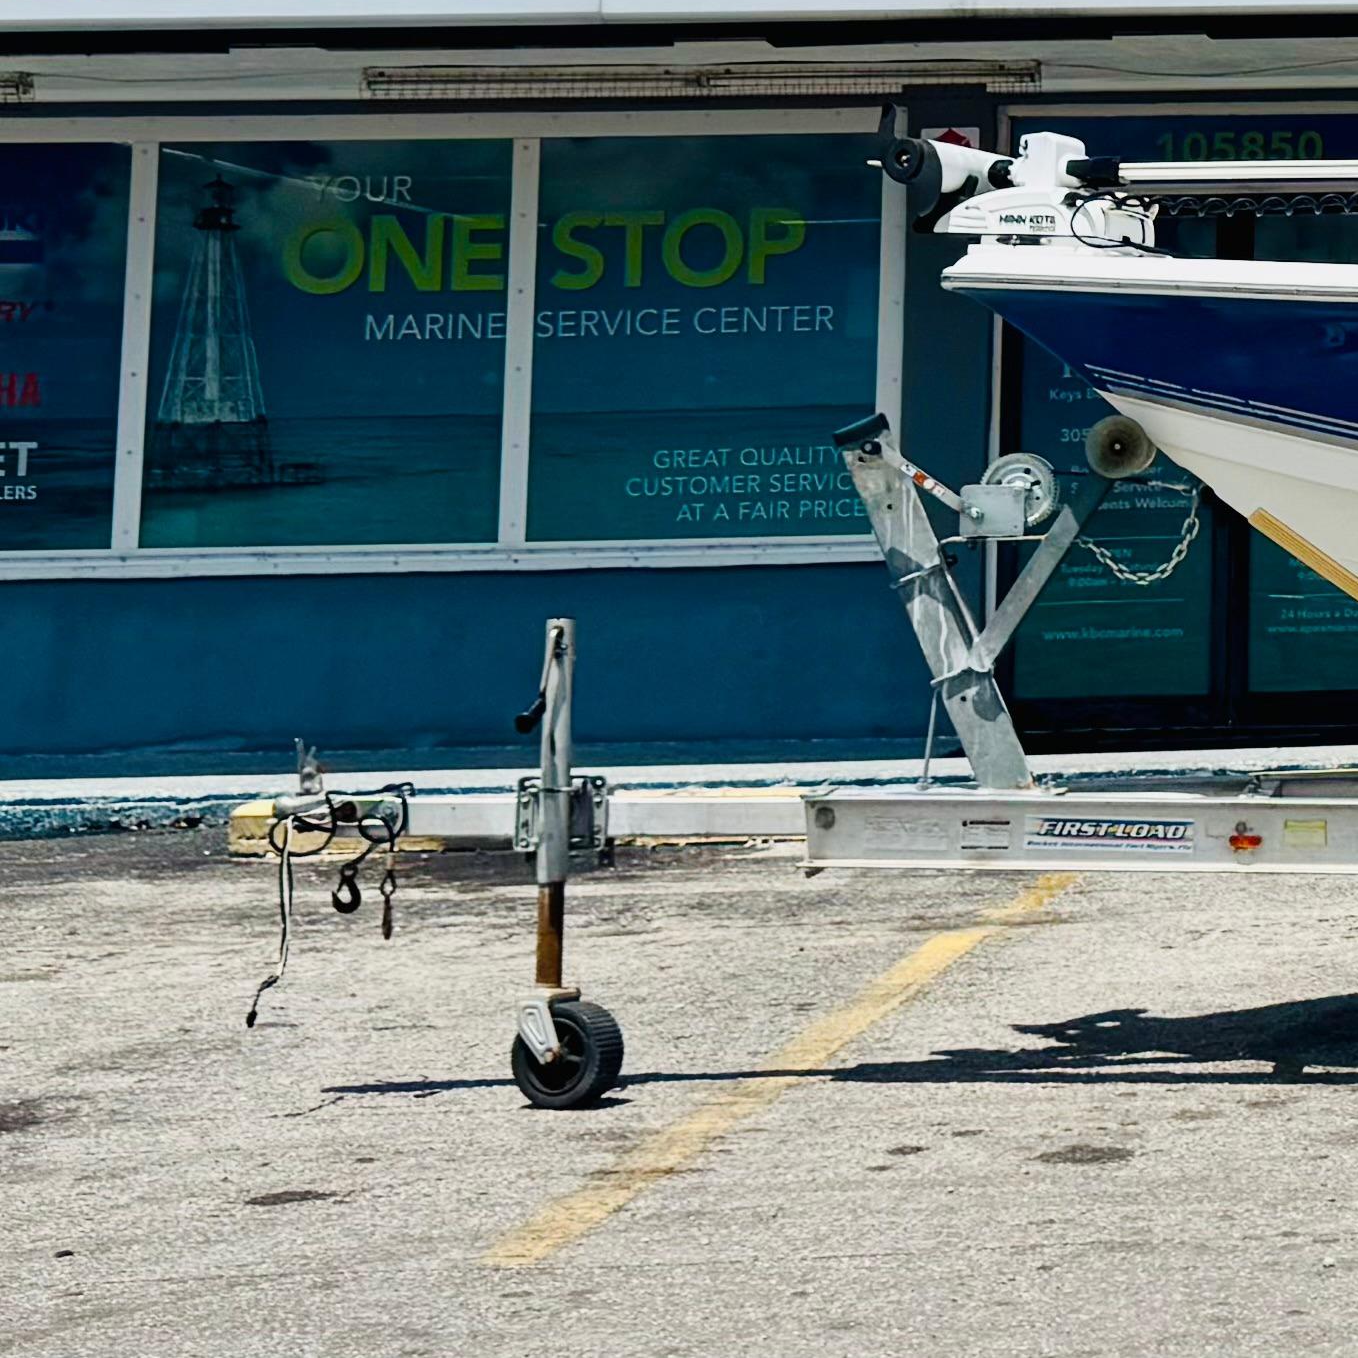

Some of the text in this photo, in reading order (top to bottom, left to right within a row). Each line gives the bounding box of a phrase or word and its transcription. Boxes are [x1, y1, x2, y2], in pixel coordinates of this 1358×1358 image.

[1158, 130, 1324, 160] 105850
[304, 175, 412, 202] YOUR
[283, 208, 807, 295] ONE STOP
[365, 305, 835, 340] MARINE SERVICE CENTER
[1049, 388, 1082, 402] Keys
[0, 441, 38, 478] T
[653, 446, 844, 469] GREAT QUALITY
[626, 472, 854, 497] CUSTOMER SERVIC
[676, 499, 868, 522] AT A FAIR PRICE
[1135, 497, 1190, 510] Welcom
